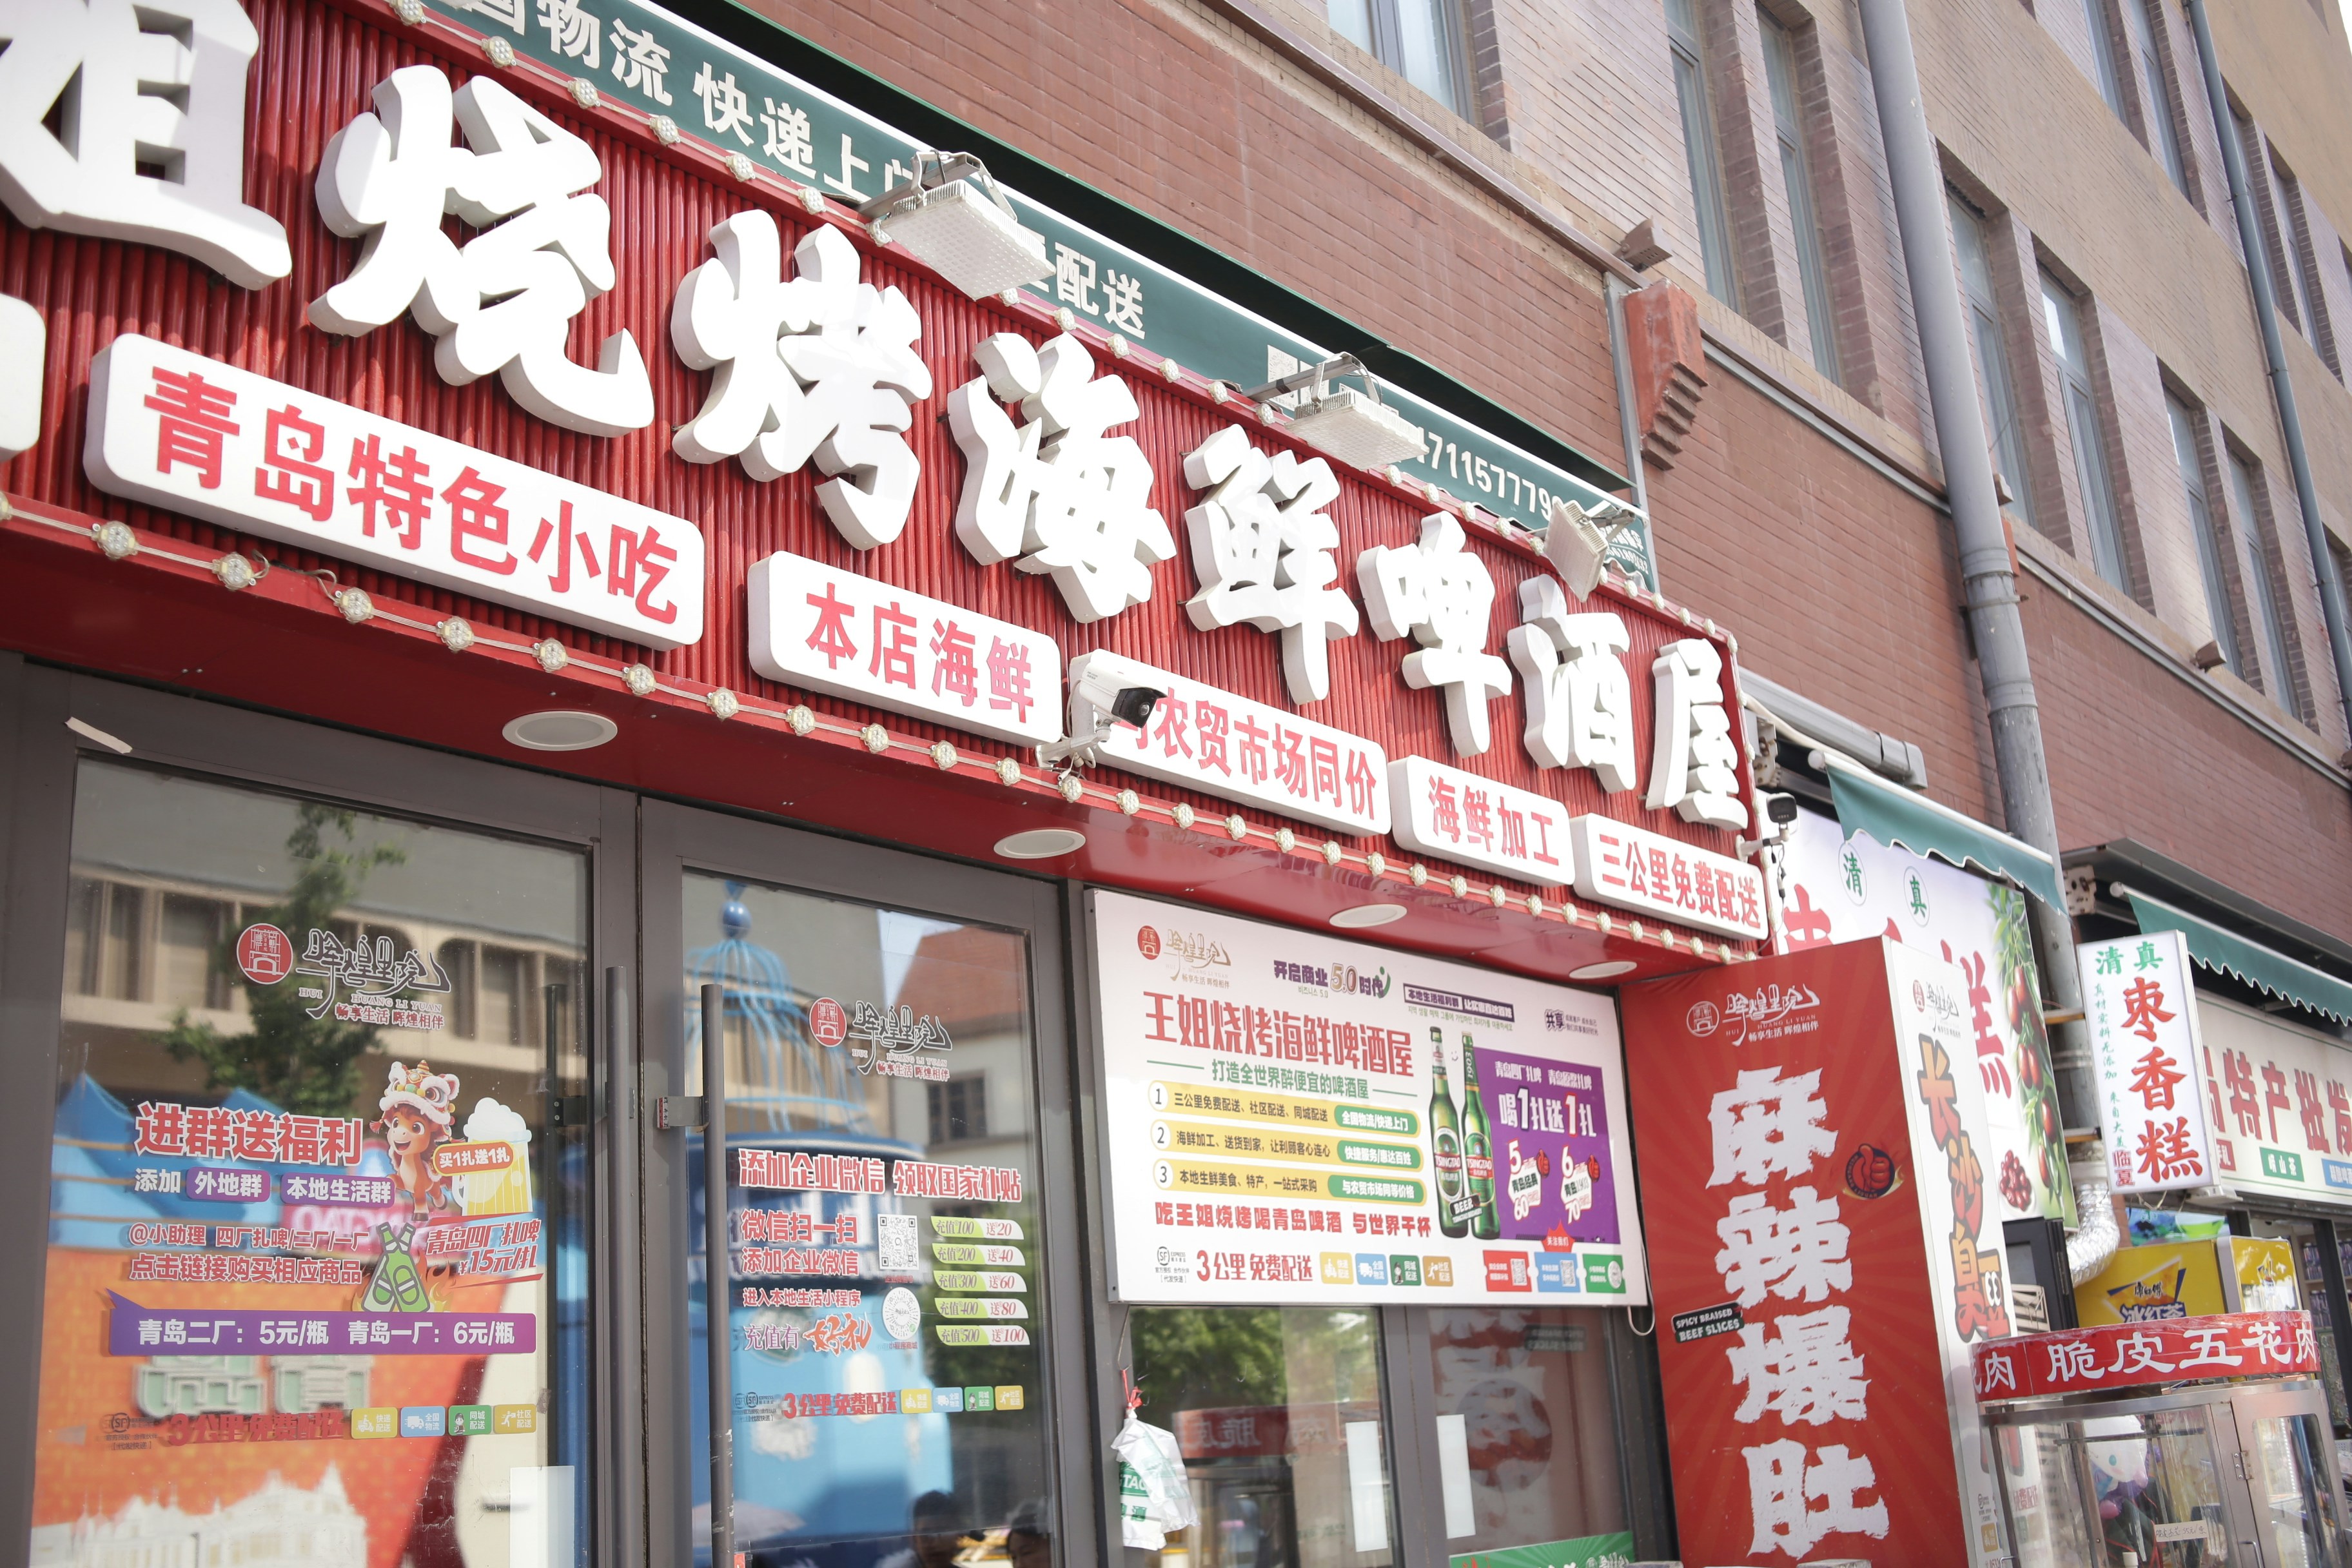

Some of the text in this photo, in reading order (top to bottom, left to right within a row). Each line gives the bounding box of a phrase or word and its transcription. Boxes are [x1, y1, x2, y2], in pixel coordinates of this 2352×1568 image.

[144, 366, 678, 625] 青岛特色小吃
[805, 582, 1034, 723] 本店海鲜
[1429, 775, 1559, 868] 海鲜加工
[1602, 833, 1761, 928] 三公里免费配送
[1274, 960, 1385, 999] 开启商业 5.0 时代
[299, 988, 323, 999] HUI
[351, 994, 392, 1007] HUANG
[335, 1003, 389, 1024] 畅享生活
[1143, 991, 1414, 1077] 王姐烧烤海鲜啤酒屋
[1749, 1028, 1782, 1042] 畅享生活
[876, 1061, 912, 1077] 畅享生活
[1211, 1059, 1369, 1099] 打造全世界醉便宜的啤酒屋
[2121, 977, 2202, 1183] 枣香糕
[1155, 1088, 1162, 1105] 1
[1174, 1092, 1328, 1122] 三公里免费配送、社区配送、同城配送
[1342, 1110, 1409, 1132] 全国物流/快递上门
[1498, 1088, 1596, 1137] 喝1扎送1扎
[133, 1100, 364, 1167] 进群送福利
[1157, 1127, 1165, 1144] 2
[439, 1147, 510, 1168] 买1扎送1扎
[1435, 1156, 1460, 1168] TSINGTAO
[1467, 1158, 1492, 1170] TSINGTAO
[1509, 1140, 1522, 1173] 5
[1562, 1146, 1574, 1177] 6
[134, 1168, 391, 1203] 添加 外地群 本地生活群
[738, 1148, 1023, 1202] 添加企业微信 领取国家补贴
[1159, 1166, 1168, 1184] 3
[1342, 1179, 1415, 1200] 与农贸市场同等价格
[1453, 1198, 1474, 1213] BEER
[1514, 1196, 1529, 1220] 60
[1565, 1199, 1581, 1224] 70
[741, 1208, 858, 1244] 微信扫一扫
[1155, 1202, 1431, 1237] 吃王姐烧烤喝青岛啤酒 与世界干杯
[129, 1222, 369, 1251] @小助理 四厂扎啤/二厂/一厂
[426, 1219, 542, 1255] 青岛四厂扎啤
[128, 1252, 362, 1284] 点击链接购买相应商品
[742, 1248, 859, 1276] 添加企业微信
[1197, 1250, 1313, 1281] 3 公里 免费配送
[743, 1287, 861, 1308] 进入本地生活小程序
[1676, 1308, 1732, 1328] SPICY BRAISED
[1705, 1065, 1890, 1558] 麻辣爆肚
[259, 1319, 329, 1346] 5元/瓶
[453, 1320, 515, 1346] 6元/瓶
[744, 1311, 873, 1357] 充值有 好礼
[1679, 1318, 1740, 1342] BEEF SLICES
[2046, 1322, 2317, 1383] 脆皮五花肉
[425, 1413, 440, 1422] 全国
[425, 1422, 440, 1431] 物流
[469, 1411, 485, 1420] 同城
[469, 1420, 485, 1430] 配送
[516, 1409, 532, 1419] 社区
[516, 1418, 532, 1428] 配送
[375, 1424, 391, 1433] 配送
